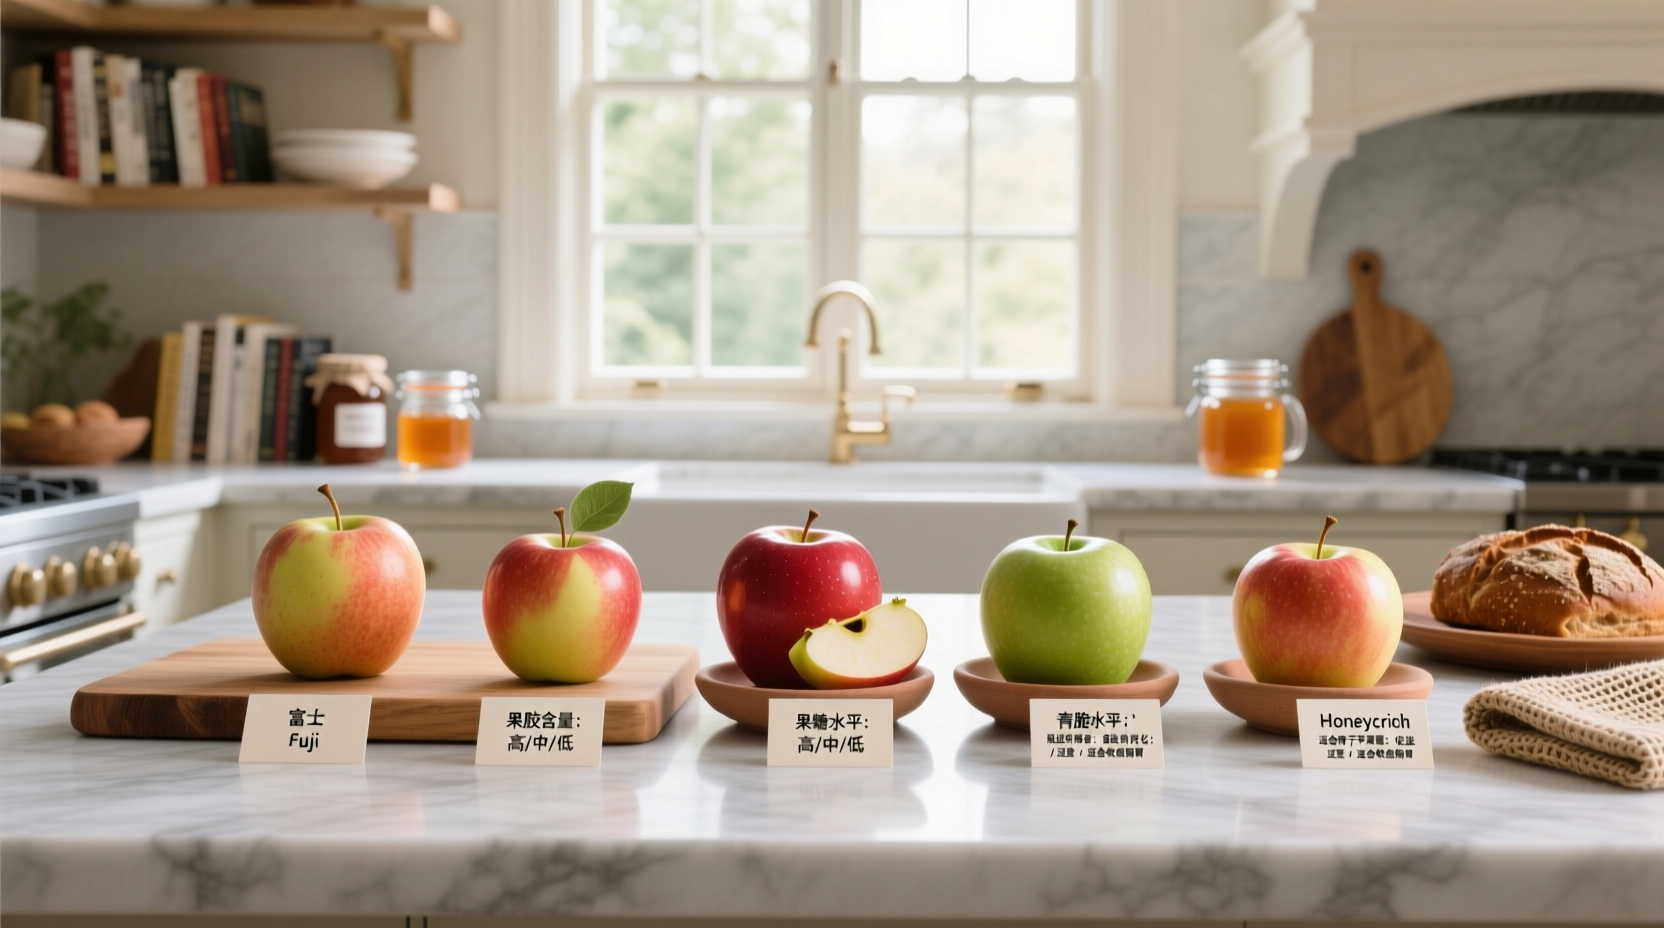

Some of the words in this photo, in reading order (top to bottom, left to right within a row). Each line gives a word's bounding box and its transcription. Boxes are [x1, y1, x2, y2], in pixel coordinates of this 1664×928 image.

[289, 708, 325, 727] 富士
[289, 733, 320, 753] Fuji
[507, 734, 574, 752] 高/中/低
[798, 735, 865, 754] 高/中/低
